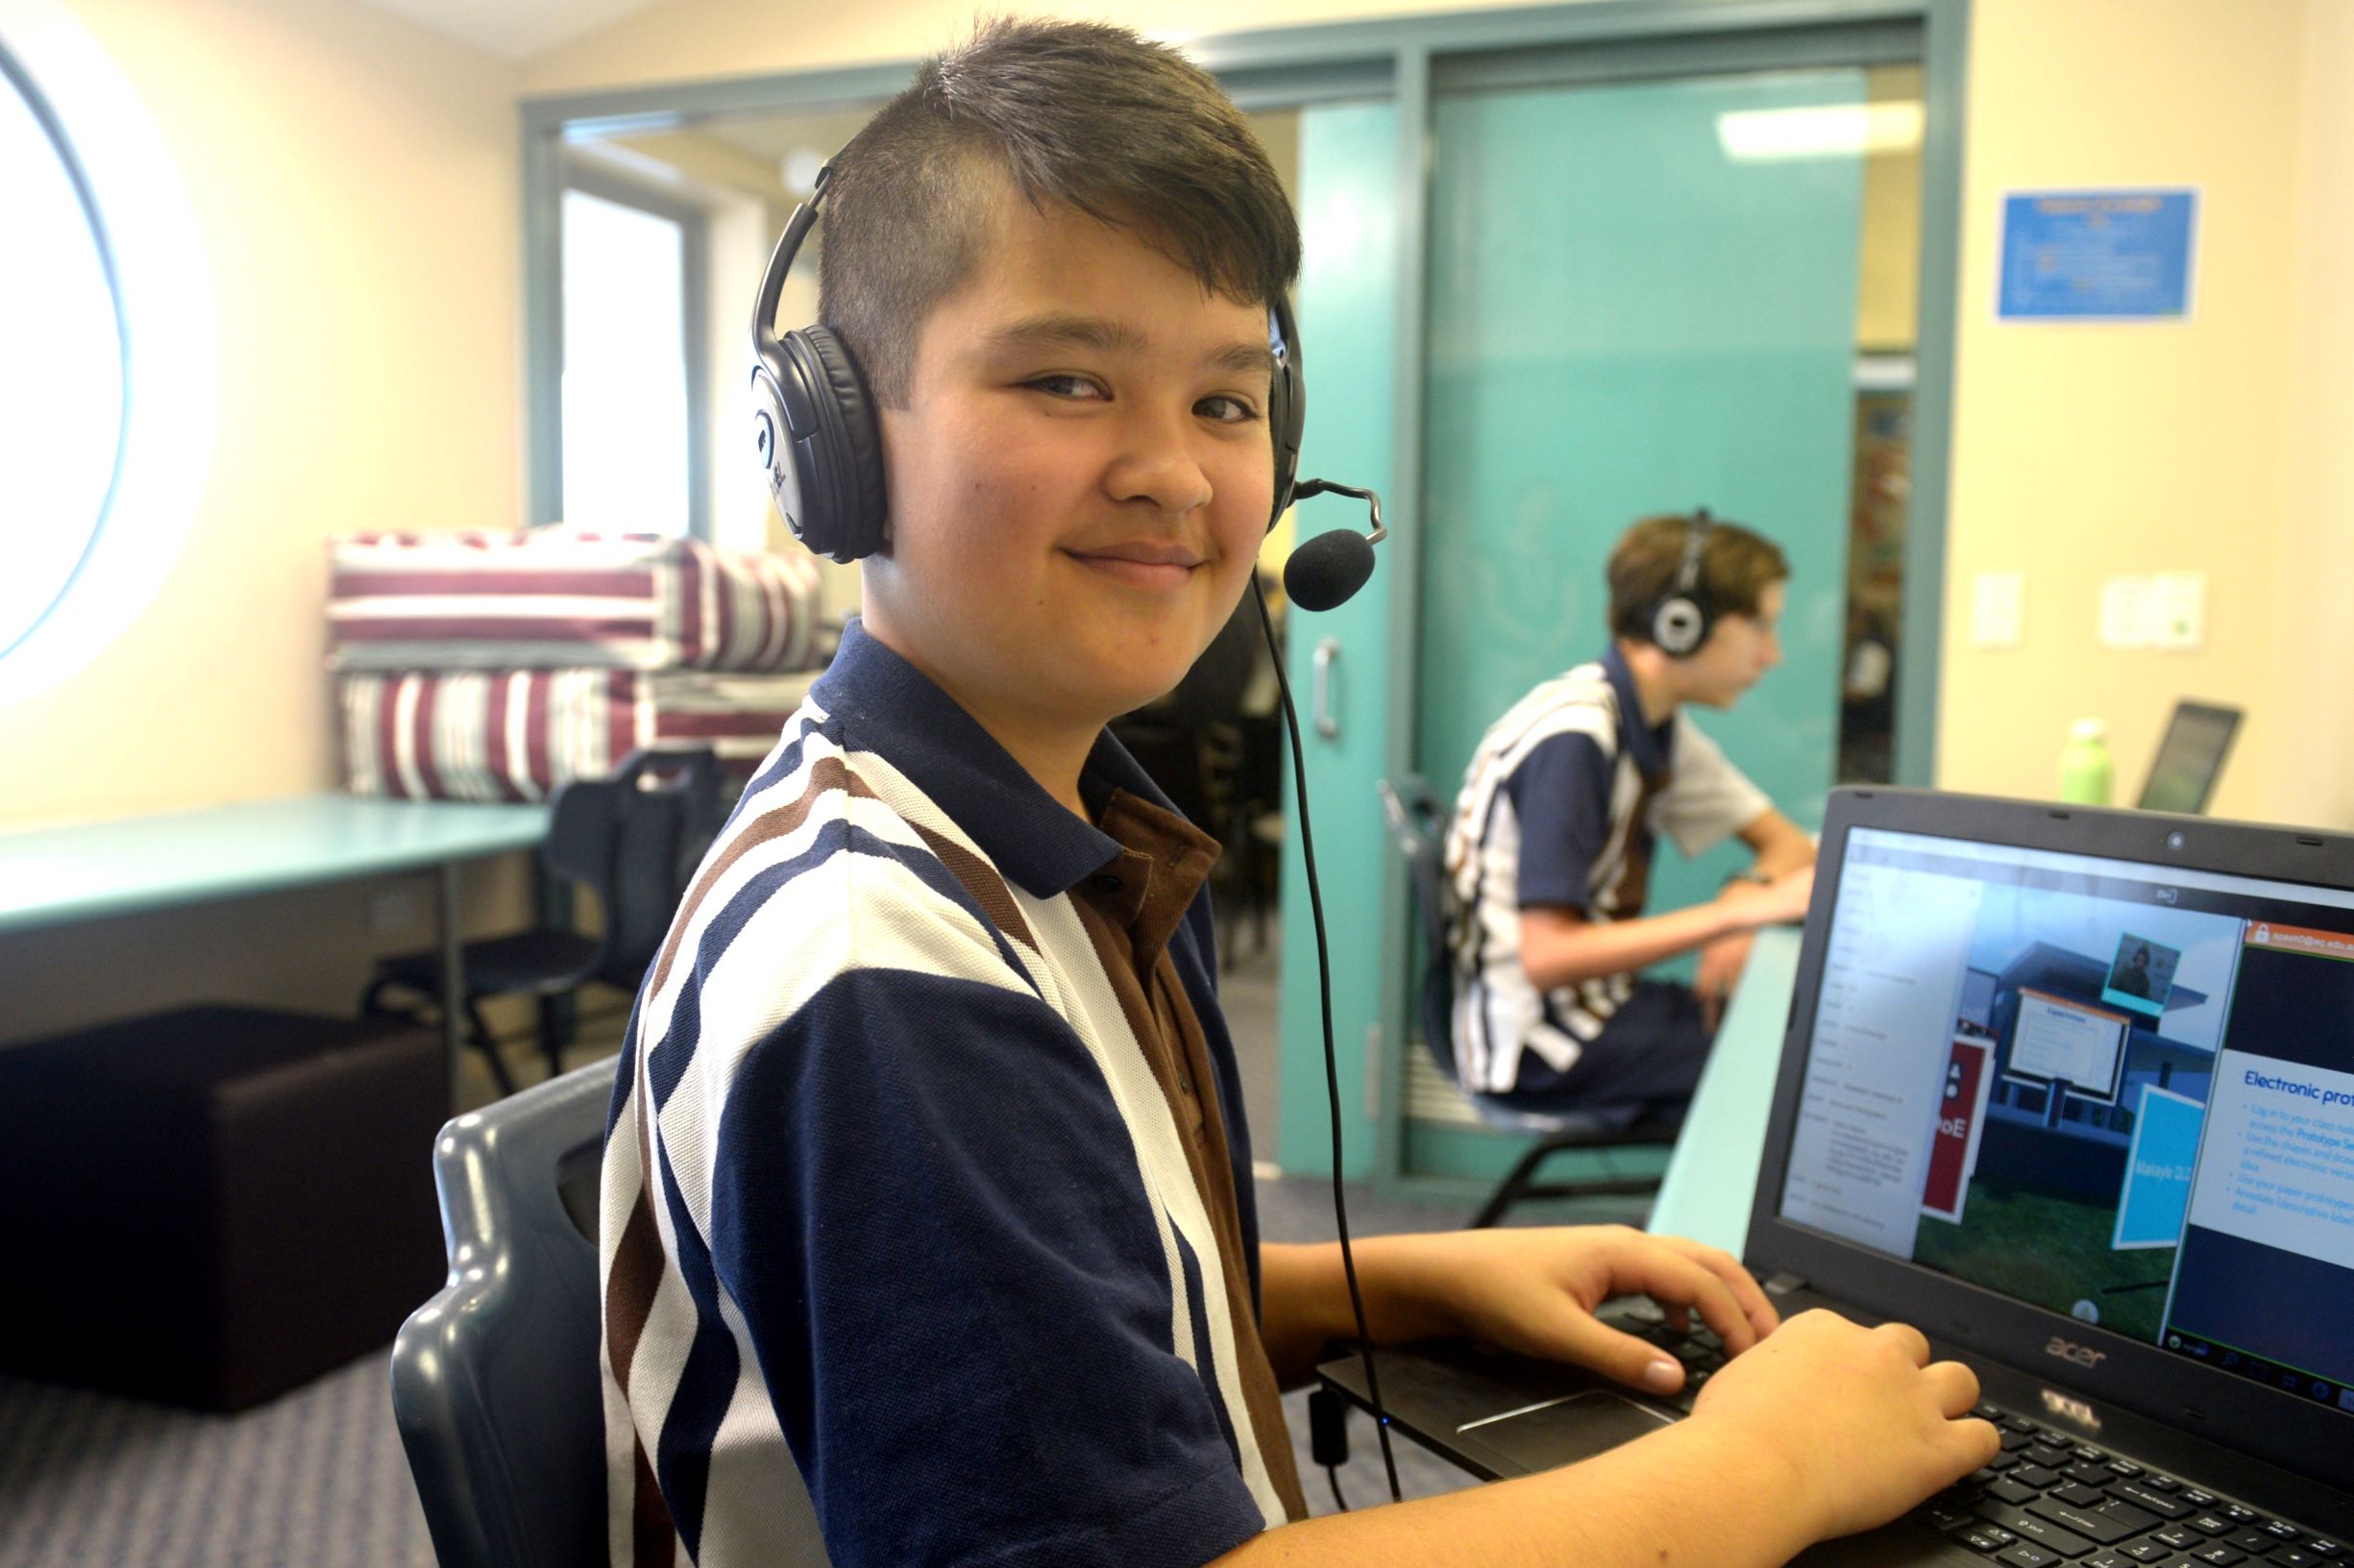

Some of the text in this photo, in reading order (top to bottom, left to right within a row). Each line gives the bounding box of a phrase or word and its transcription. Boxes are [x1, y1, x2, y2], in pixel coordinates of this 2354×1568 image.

[2244, 1070, 2320, 1098] Electronic
[1937, 1116, 1967, 1139] oE
[2297, 1129, 2341, 1147] Prototype
[2284, 1156, 2327, 1172] electronic
[2046, 1336, 2107, 1370] acer
